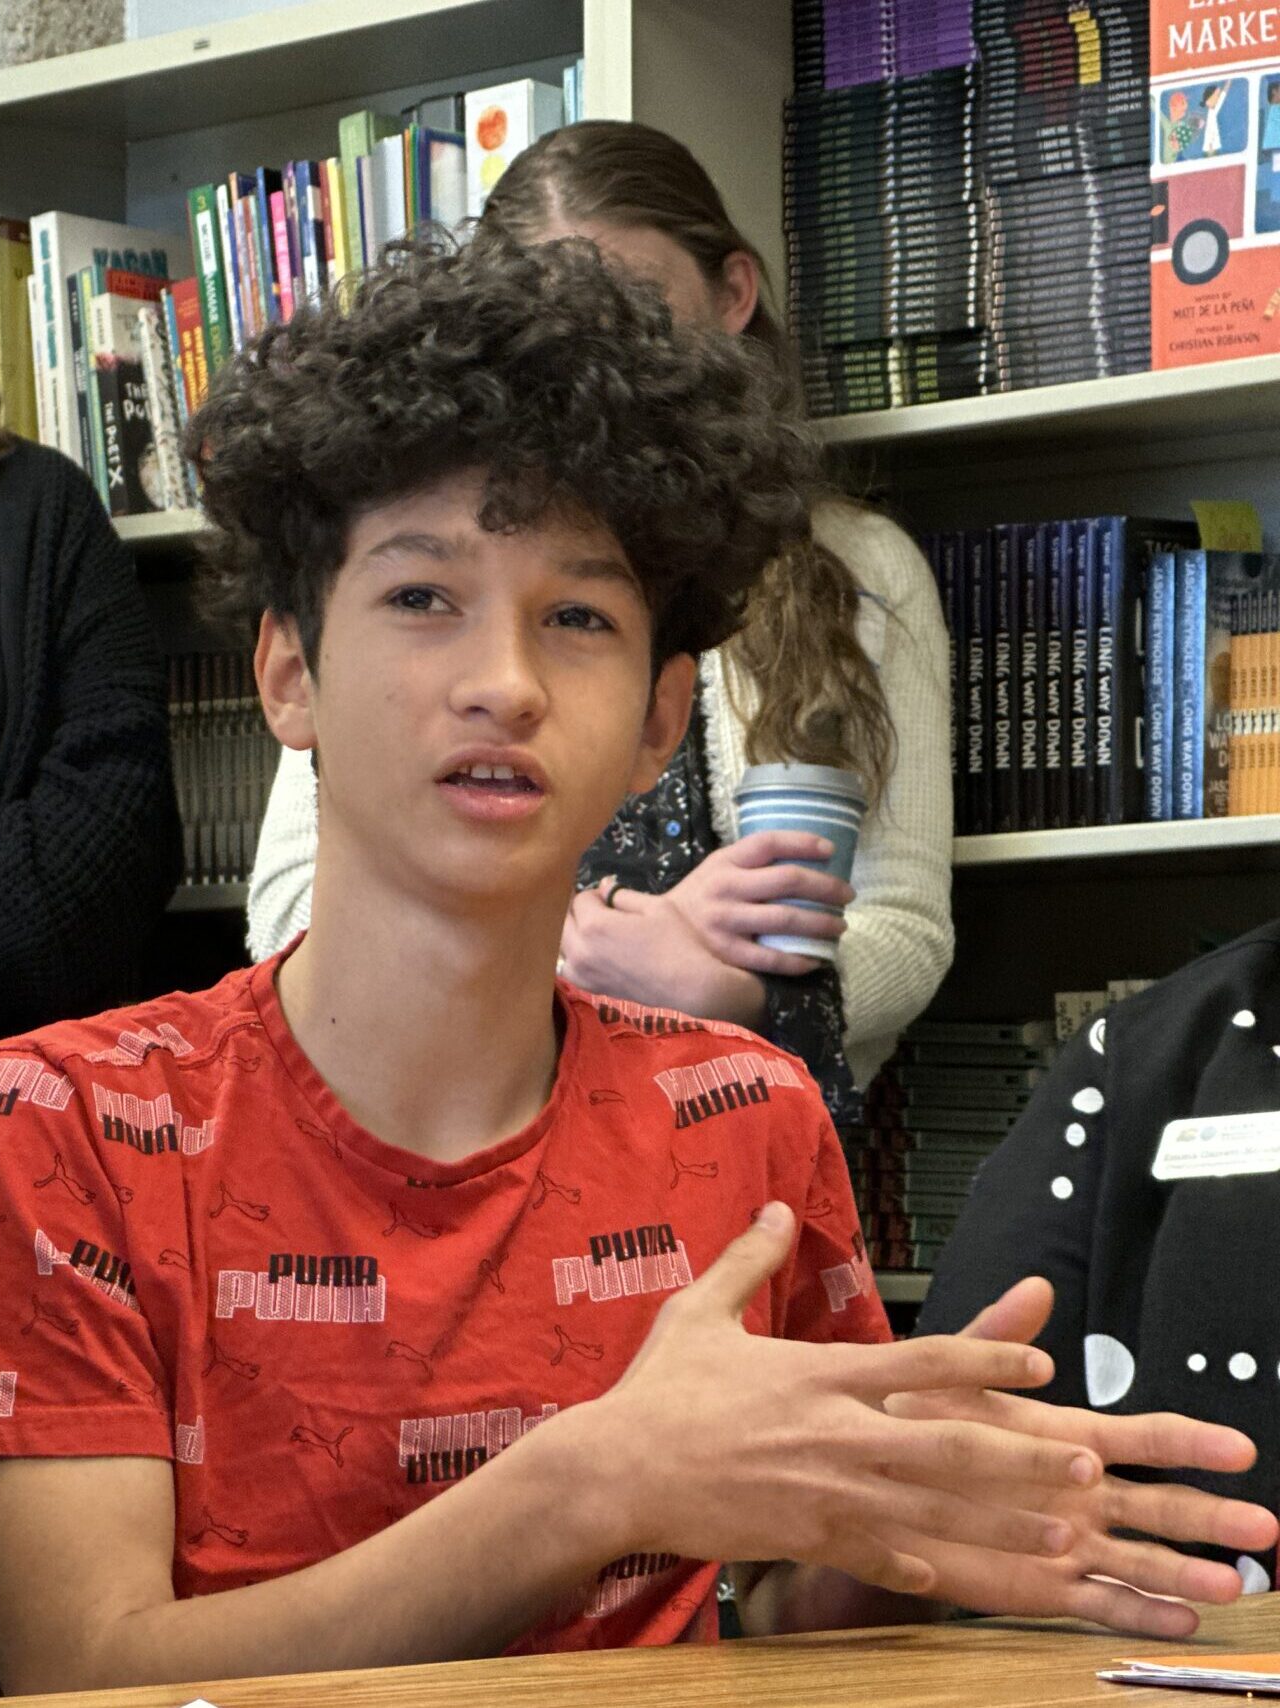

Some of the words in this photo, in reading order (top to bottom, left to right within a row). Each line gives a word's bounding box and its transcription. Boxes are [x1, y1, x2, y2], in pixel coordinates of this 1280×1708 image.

[1168, 8, 1280, 58] MARKE
[1214, 303, 1227, 315] LA
[108, 465, 124, 488] X
[1151, 564, 1164, 609] JASON
[1183, 560, 1196, 604] JASON
[969, 637, 984, 681] LONG
[996, 633, 1010, 677] LONG
[1022, 632, 1036, 677] LONG
[1047, 631, 1061, 674] LONG
[1072, 629, 1087, 673] LONG
[1098, 627, 1113, 672] LONG
[970, 686, 982, 719] WAY
[997, 681, 1008, 715] WAY
[1023, 681, 1034, 715] WAY
[1048, 679, 1059, 714] WAY
[1073, 679, 1085, 712] WAY
[1099, 676, 1111, 711] WAY
[1151, 703, 1163, 740] LONG
[1182, 700, 1194, 736] LONG
[969, 724, 983, 773] DOWN
[996, 721, 1010, 769] DOWN
[1022, 720, 1036, 769] DOWN
[1047, 719, 1061, 768] DOWN
[1072, 718, 1086, 767] DOWN
[1098, 716, 1112, 765] DOWN
[1151, 743, 1163, 772] WAY
[1182, 739, 1193, 771] WAY
[1151, 776, 1163, 818] DOWN
[1181, 774, 1193, 815] DOWN
[674, 1077, 771, 1130] PUMA
[102, 1114, 179, 1155] UMA
[589, 1223, 679, 1266] PUMA
[69, 1239, 136, 1296] PU
[269, 1253, 378, 1288] PUMA
[552, 1240, 694, 1306] PUMA
[216, 1269, 386, 1323] PUMA
[406, 1446, 489, 1485] UMA
